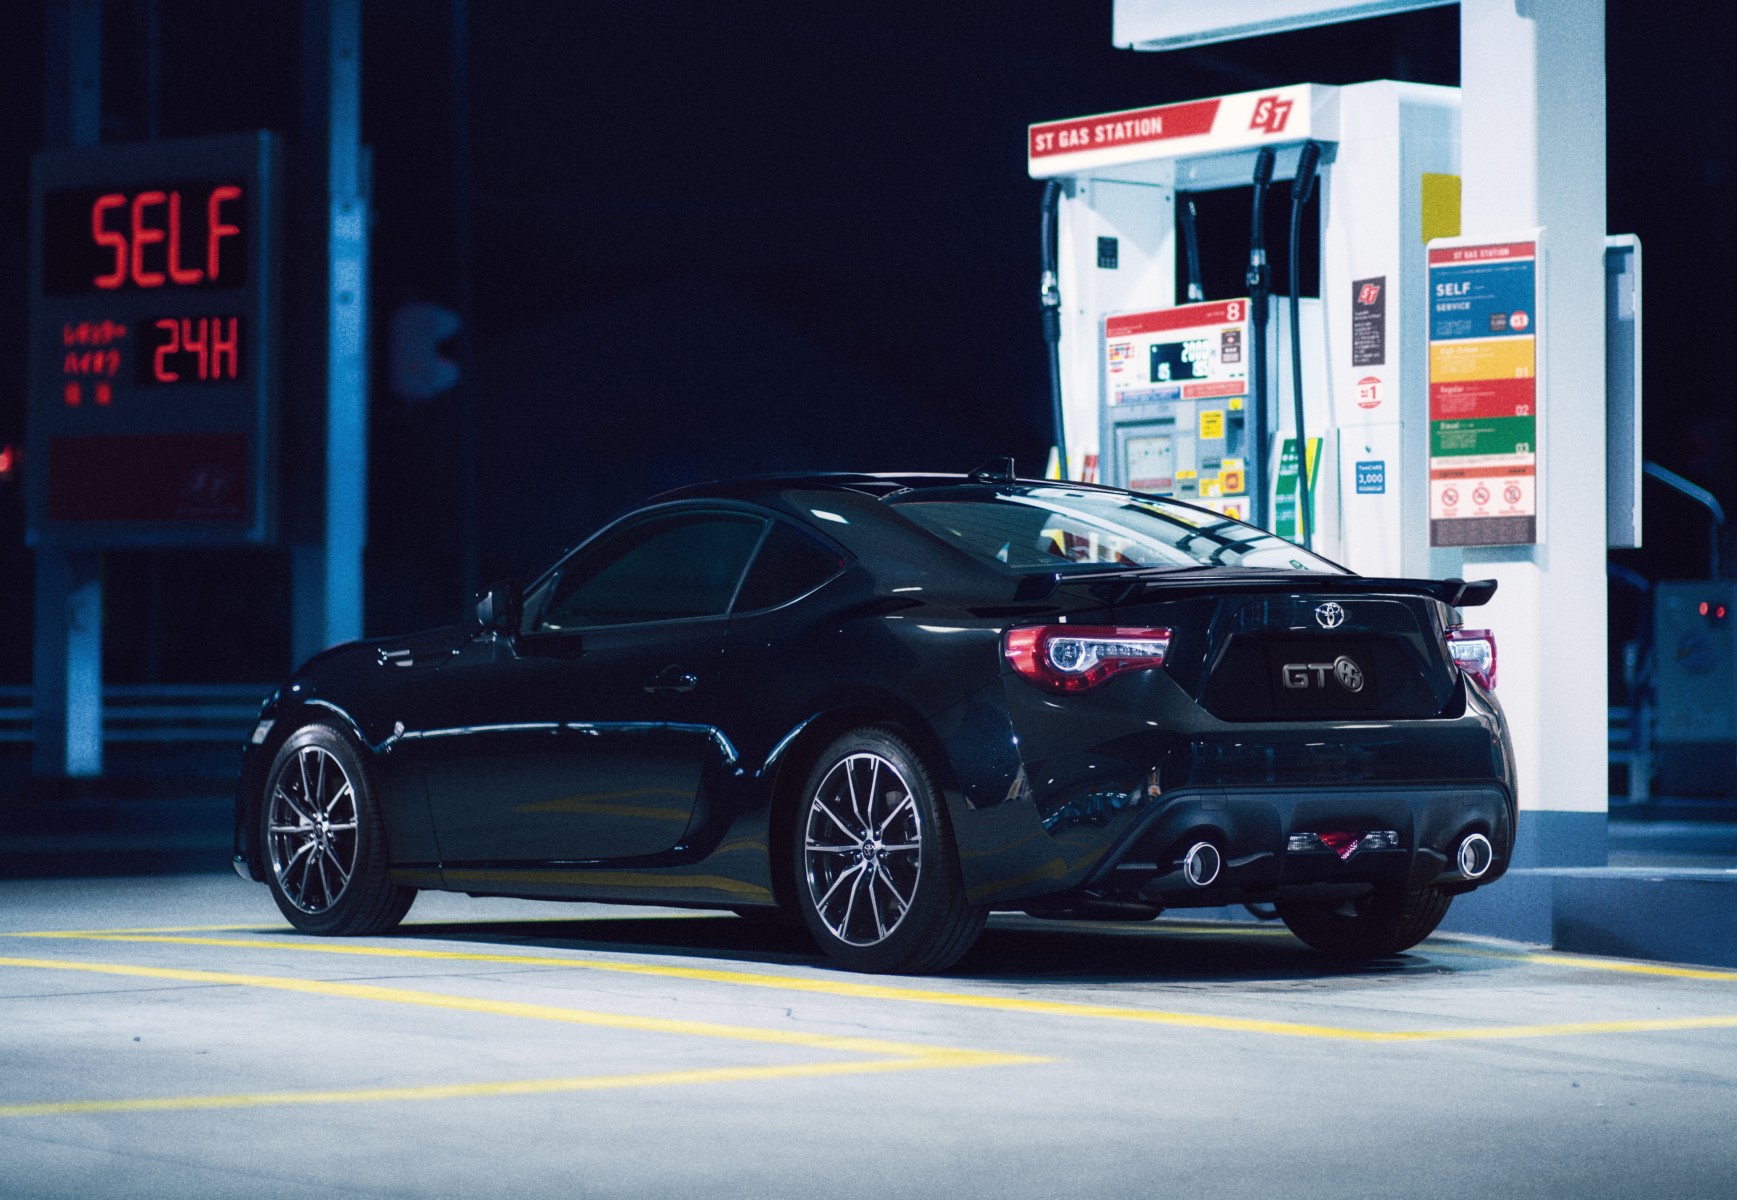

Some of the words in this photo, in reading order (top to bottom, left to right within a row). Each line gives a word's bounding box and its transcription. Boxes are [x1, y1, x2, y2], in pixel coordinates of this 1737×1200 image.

[1252, 100, 1291, 131] ST
[1034, 133, 1054, 152] ST
[1058, 127, 1091, 149] GAS
[1094, 117, 1163, 143] STATION
[92, 185, 243, 290] SELF
[1480, 248, 1510, 258] STATION
[1359, 285, 1379, 304] ST
[1436, 281, 1472, 297] SELF
[1226, 302, 1240, 321] 8
[1435, 301, 1471, 312] SERVICE
[153, 316, 238, 382] 24H
[1515, 404, 1529, 416] 02
[1358, 473, 1384, 486] 3,000
